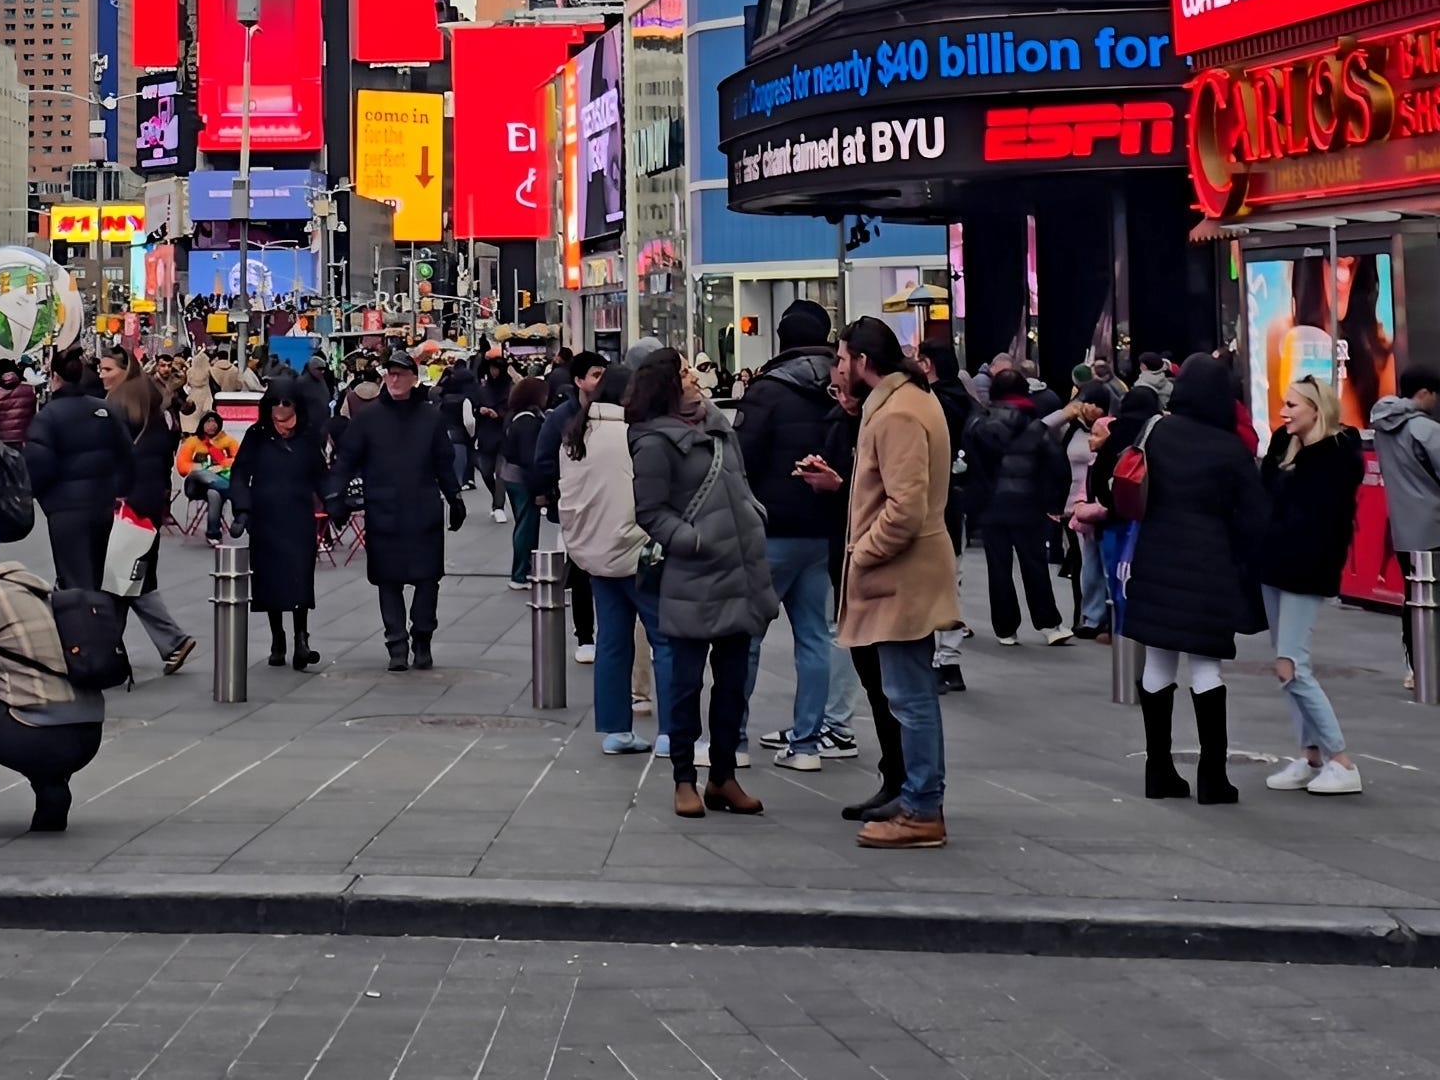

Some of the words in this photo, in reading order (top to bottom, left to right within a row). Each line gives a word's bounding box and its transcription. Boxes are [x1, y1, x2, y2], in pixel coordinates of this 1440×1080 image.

[792, 63, 811, 100] for
[812, 49, 872, 97] nearly
[876, 38, 929, 88] $40
[939, 30, 1081, 79] billion
[1094, 26, 1170, 69] for
[364, 110, 410, 123] come
[792, 126, 839, 173] aimed
[842, 126, 866, 166] at
[871, 116, 945, 163] BYU
[983, 101, 1175, 163] ESPN
